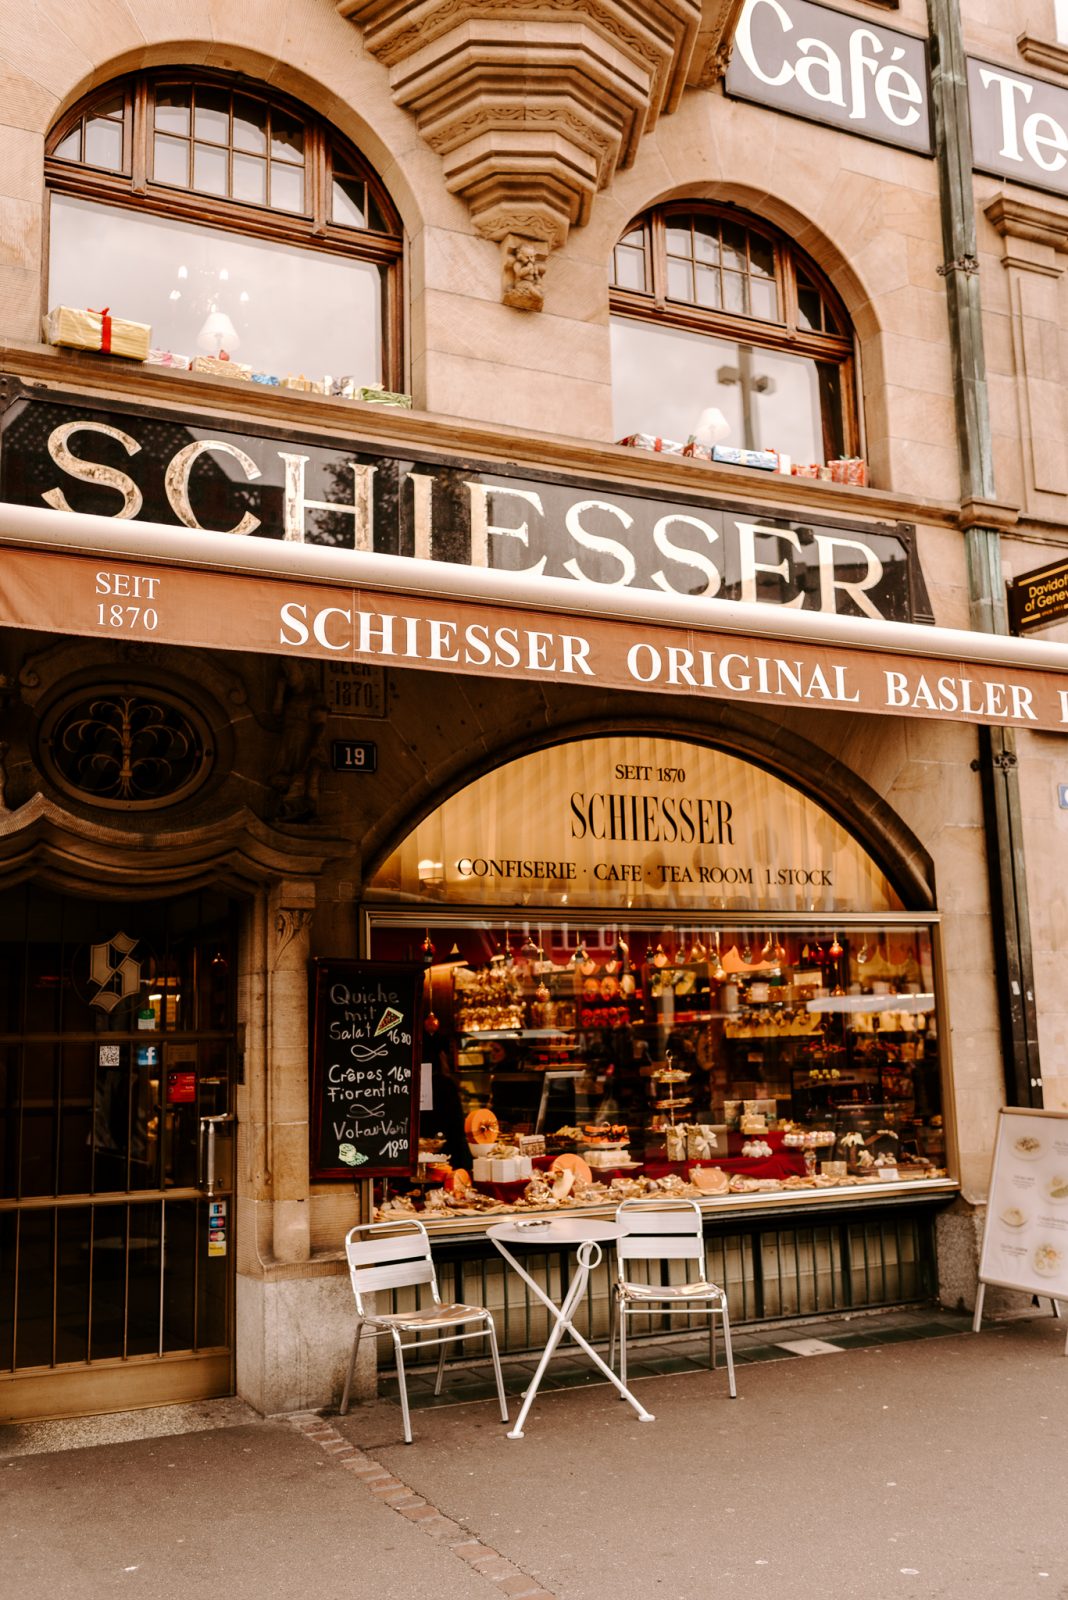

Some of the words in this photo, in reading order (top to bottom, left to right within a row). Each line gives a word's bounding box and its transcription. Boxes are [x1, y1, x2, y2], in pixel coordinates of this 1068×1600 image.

[735, 0, 923, 127] Café
[979, 68, 1068, 172] Te
[41, 420, 886, 621] SCHIESSER
[95, 571, 160, 600] SEIT
[96, 603, 159, 631] 1870
[1025, 598, 1035, 612] of
[279, 602, 596, 677] SCHIESSER
[627, 642, 860, 704] ORIGINAL
[883, 670, 1038, 721] BASLER
[335, 680, 373, 708] 1870
[344, 747, 365, 766] 19
[615, 764, 653, 781] SEIT
[657, 766, 686, 783] 1870
[570, 791, 735, 845] SCHIESSER
[457, 858, 577, 880] CONFISERIE
[594, 863, 642, 882] CAFE
[657, 864, 693, 883] TEA
[699, 866, 754, 885] ROOM
[330, 983, 400, 1005] Quiche
[345, 1006, 377, 1022] mit
[330, 1022, 372, 1040] Salat
[328, 1064, 383, 1084] Crêpes
[327, 1080, 410, 1103] Fiorentina
